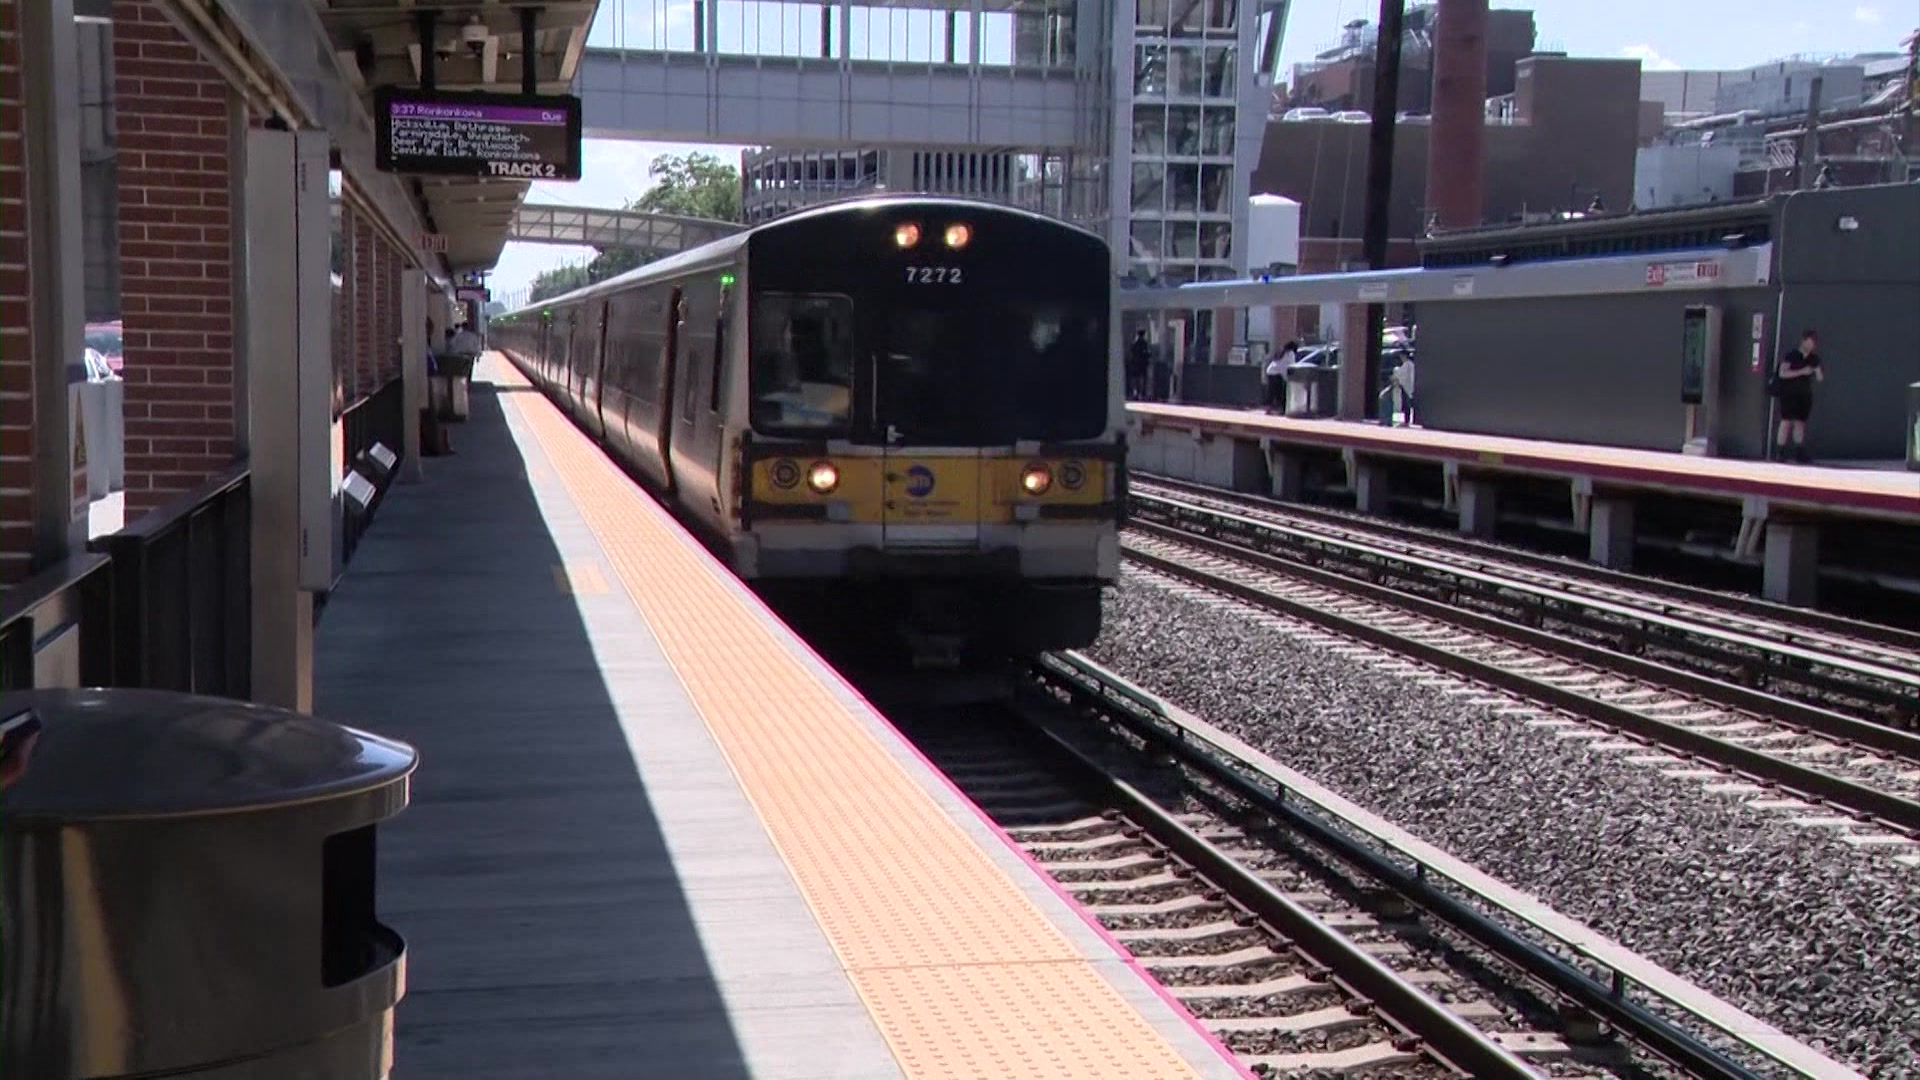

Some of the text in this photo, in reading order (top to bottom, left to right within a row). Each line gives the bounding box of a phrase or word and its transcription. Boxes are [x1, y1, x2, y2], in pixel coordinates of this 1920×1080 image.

[542, 111, 562, 121] Due
[488, 161, 556, 177] TRACK 2
[905, 266, 962, 284] 7272
